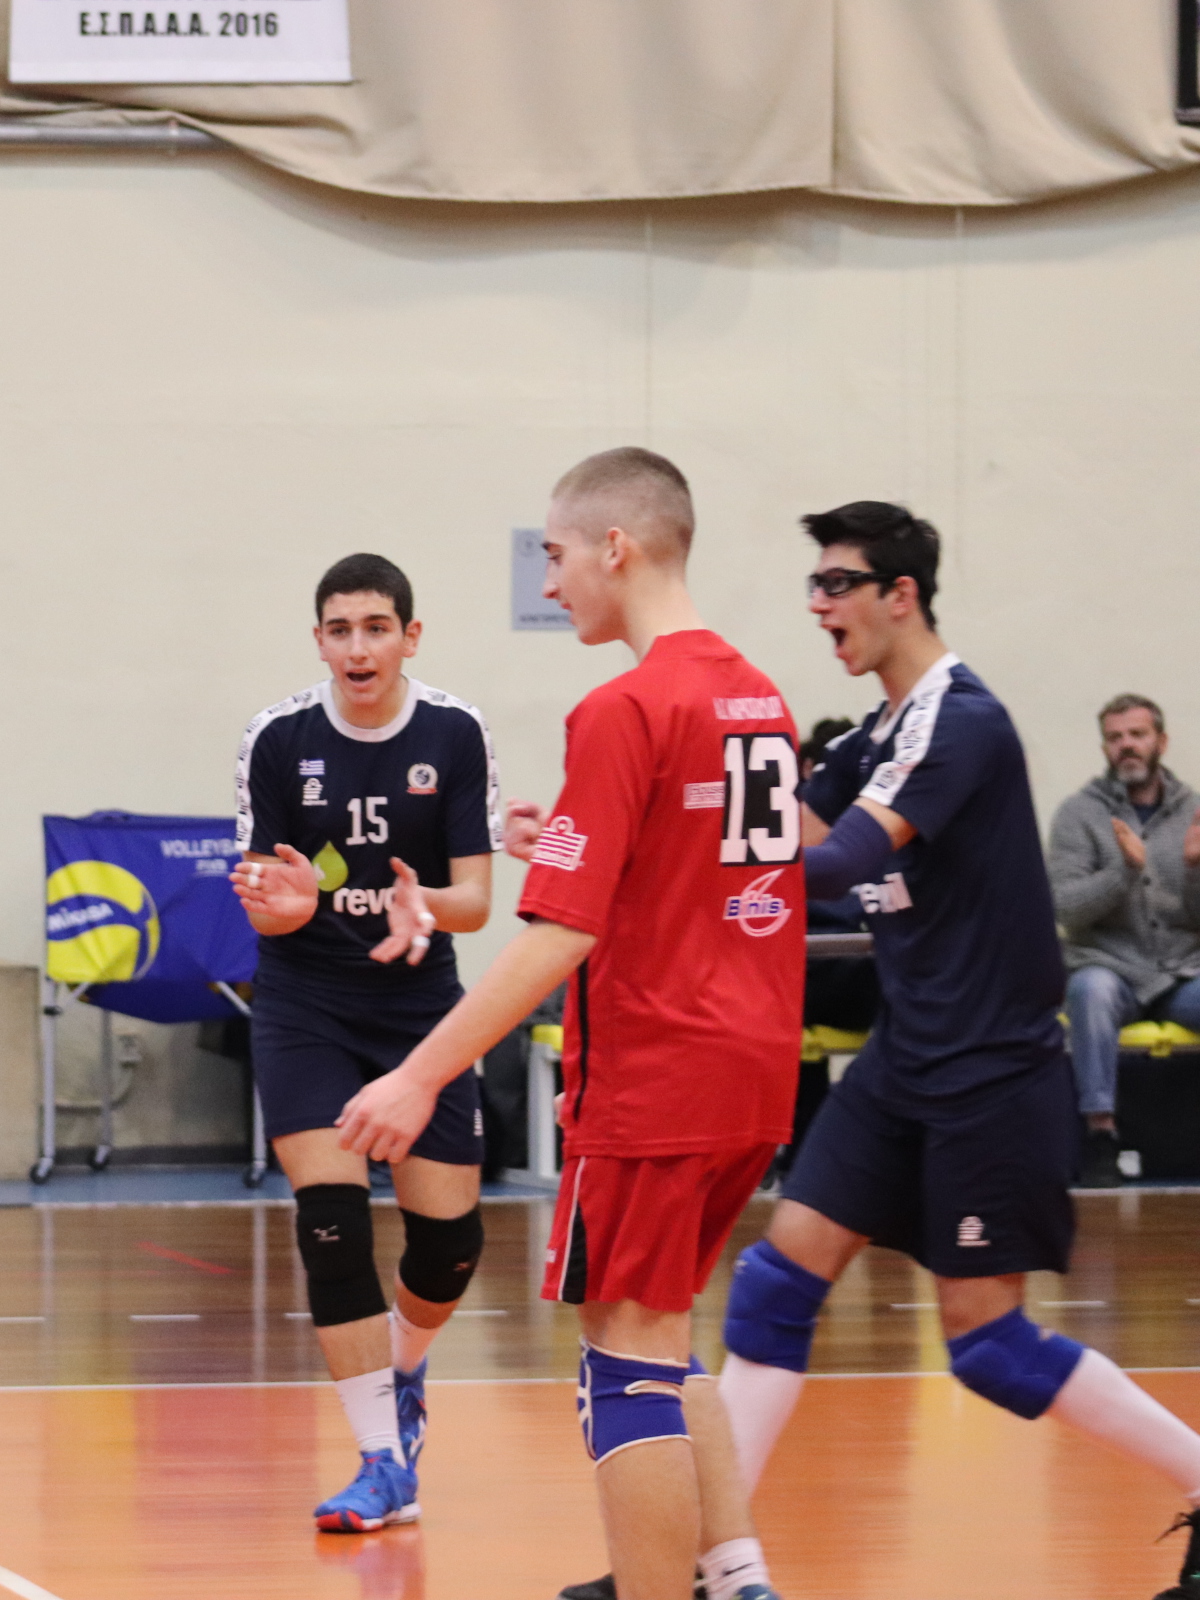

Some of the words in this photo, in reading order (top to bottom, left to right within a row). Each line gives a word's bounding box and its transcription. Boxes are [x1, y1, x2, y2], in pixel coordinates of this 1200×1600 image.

[219, 12, 279, 37] 2016
[720, 736, 799, 862] 13
[345, 796, 389, 845] 15
[160, 839, 242, 858] VOLLEYB
[333, 887, 397, 916] revo
